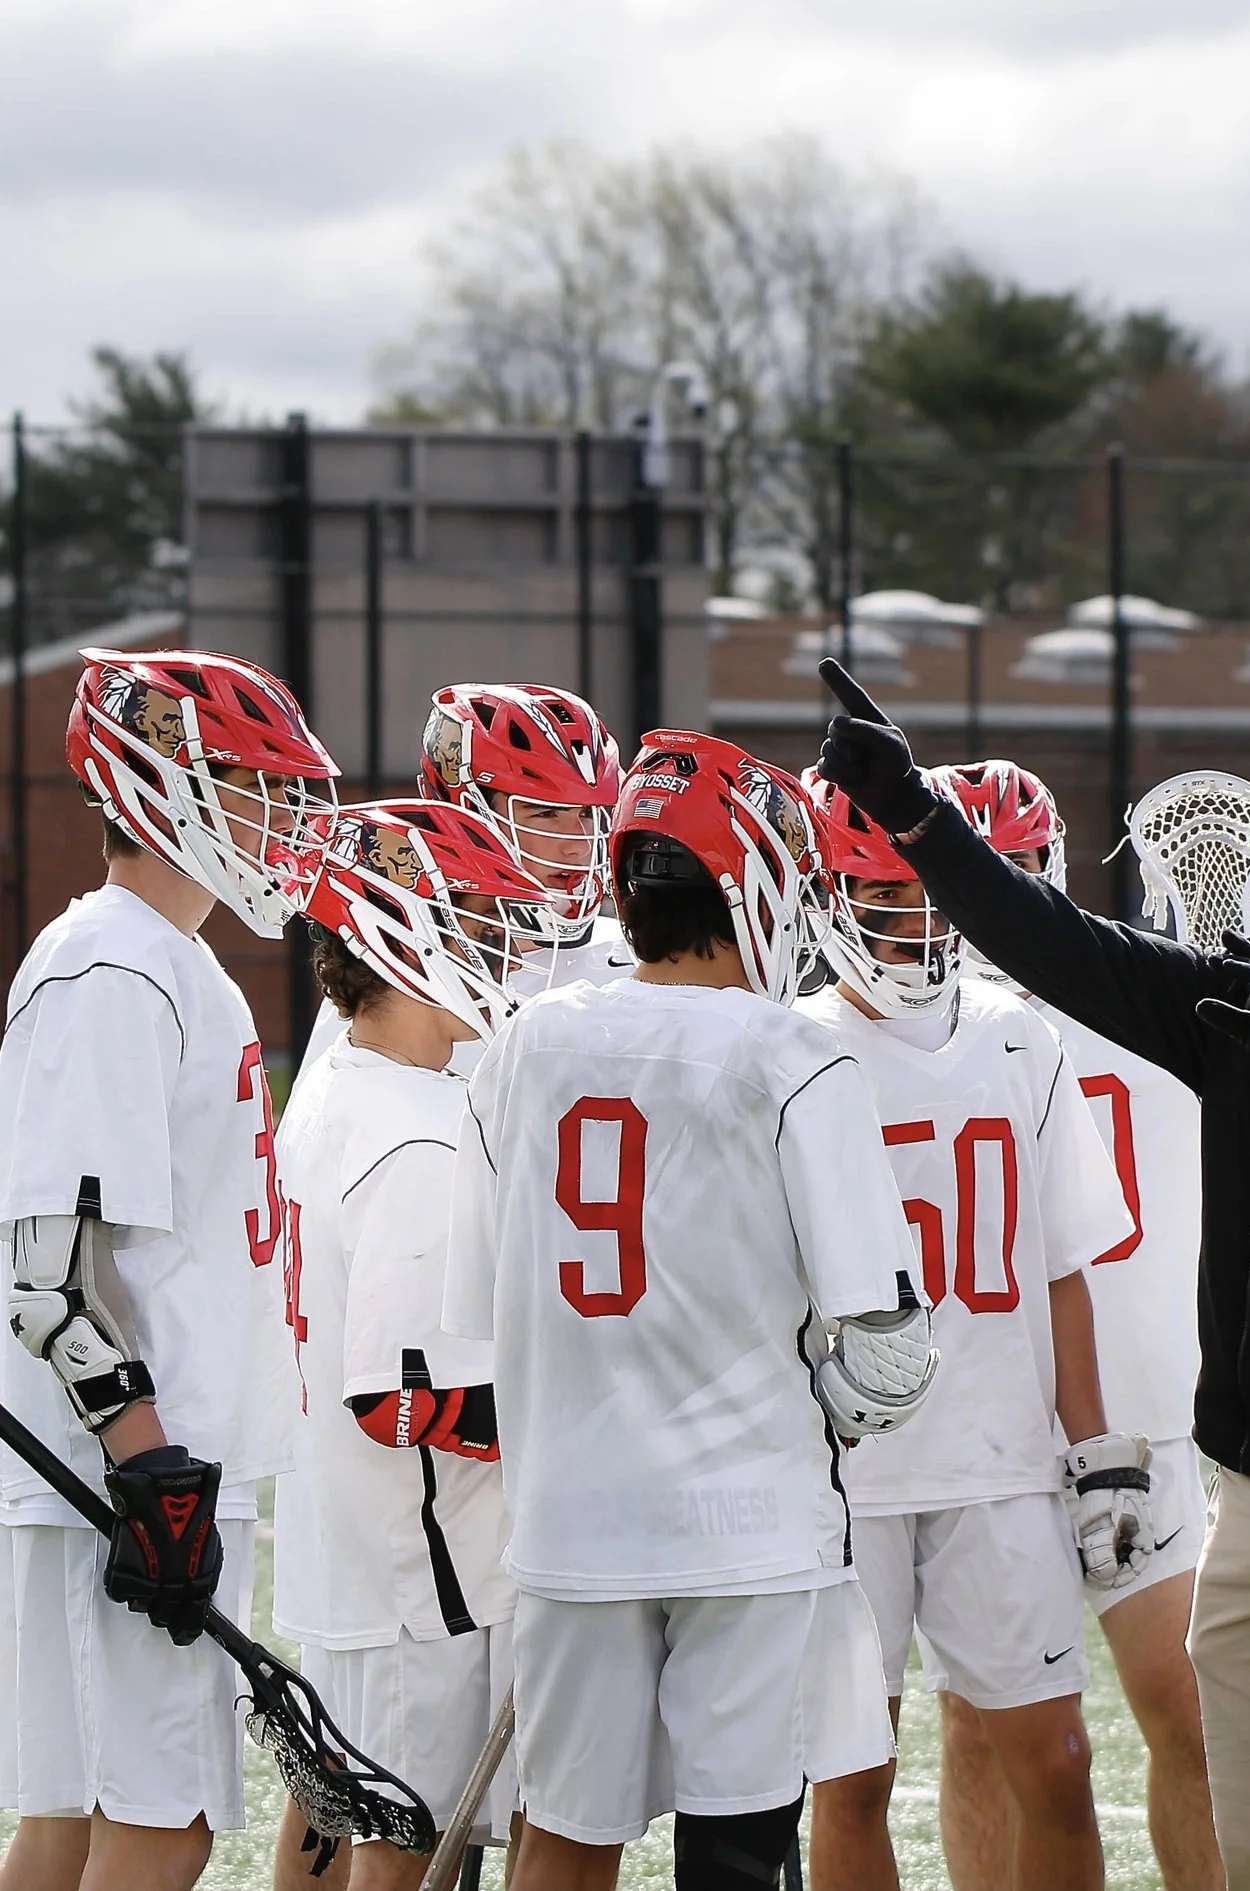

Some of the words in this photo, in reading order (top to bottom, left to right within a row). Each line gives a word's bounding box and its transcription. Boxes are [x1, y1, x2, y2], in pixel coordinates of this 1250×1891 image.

[554, 1095, 648, 1318] 9
[877, 1117, 1021, 1314] 50
[67, 1340, 89, 1355] 500
[396, 1388, 413, 1446] BRINE
[1077, 1455, 1087, 1469] 5
